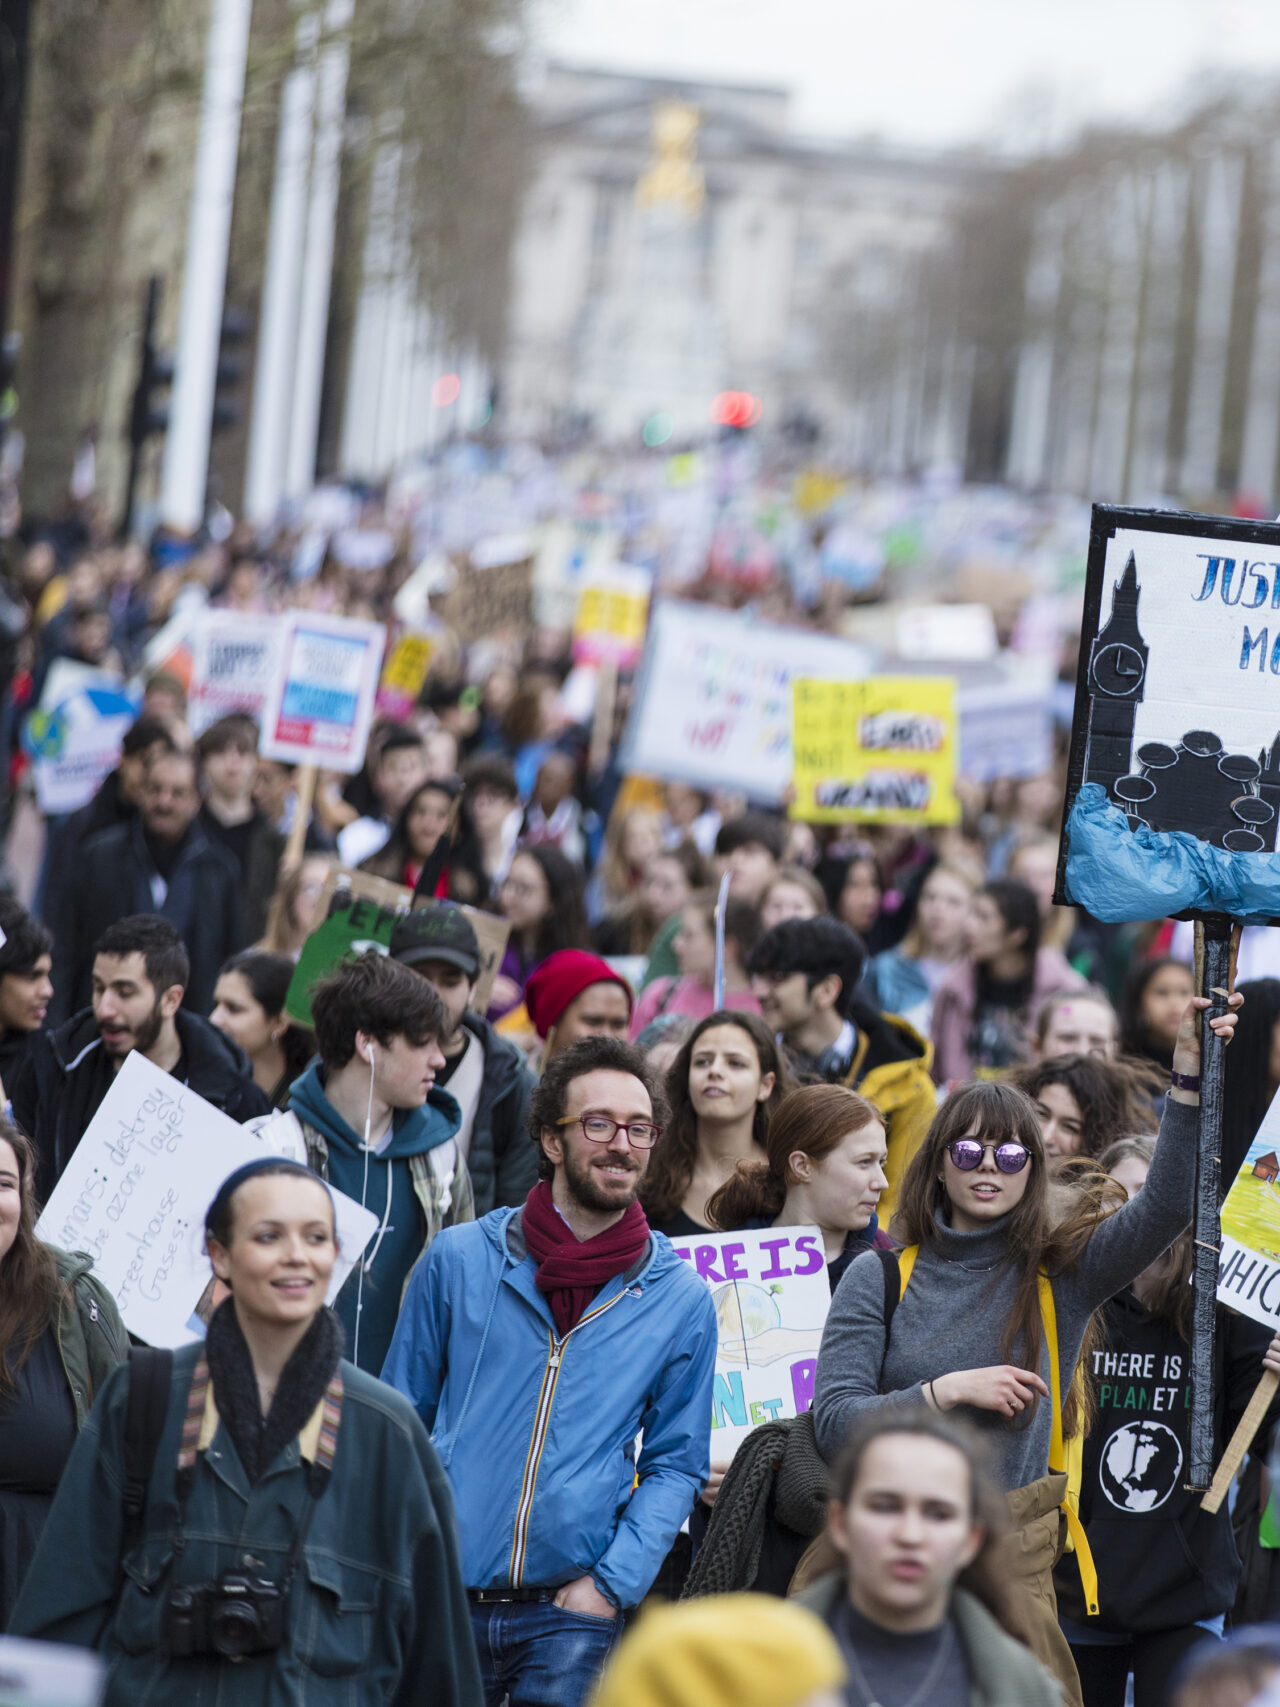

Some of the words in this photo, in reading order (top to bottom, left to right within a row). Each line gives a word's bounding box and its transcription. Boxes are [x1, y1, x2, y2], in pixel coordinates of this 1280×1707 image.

[104, 1087, 175, 1167] destroy
[137, 1094, 187, 1156] layer
[138, 1218, 189, 1302] Gases:
[759, 1236, 824, 1281] IS
[1092, 1350, 1156, 1379] THERE
[1162, 1355, 1182, 1380] IS
[1100, 1384, 1179, 1412] PLANET
